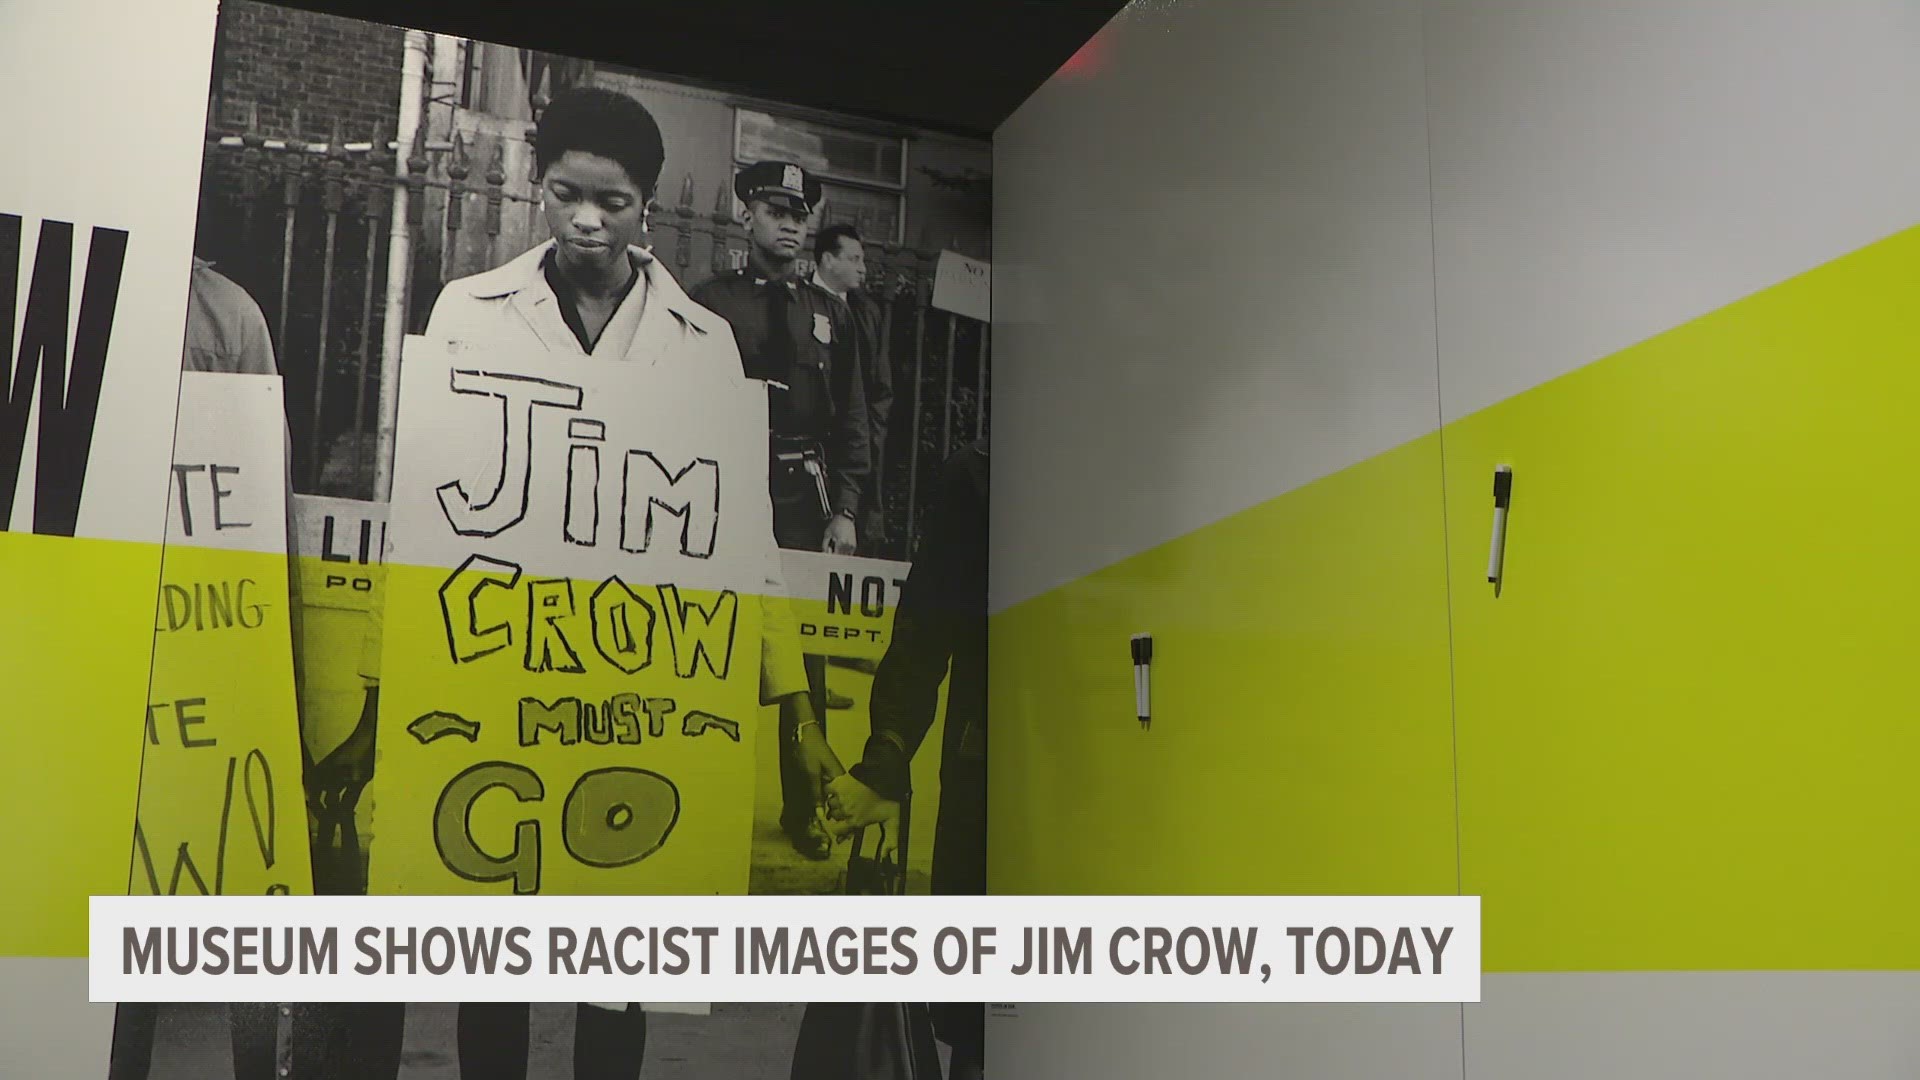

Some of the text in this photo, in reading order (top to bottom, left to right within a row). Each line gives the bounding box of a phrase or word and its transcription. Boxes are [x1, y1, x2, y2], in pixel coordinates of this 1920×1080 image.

[171, 464, 252, 536] TE
[321, 515, 387, 566] LI
[326, 574, 372, 592] PO
[438, 554, 738, 680] CROW
[800, 623, 884, 644] DEPT.
[518, 692, 676, 746] MUST
[433, 760, 680, 895] GO
